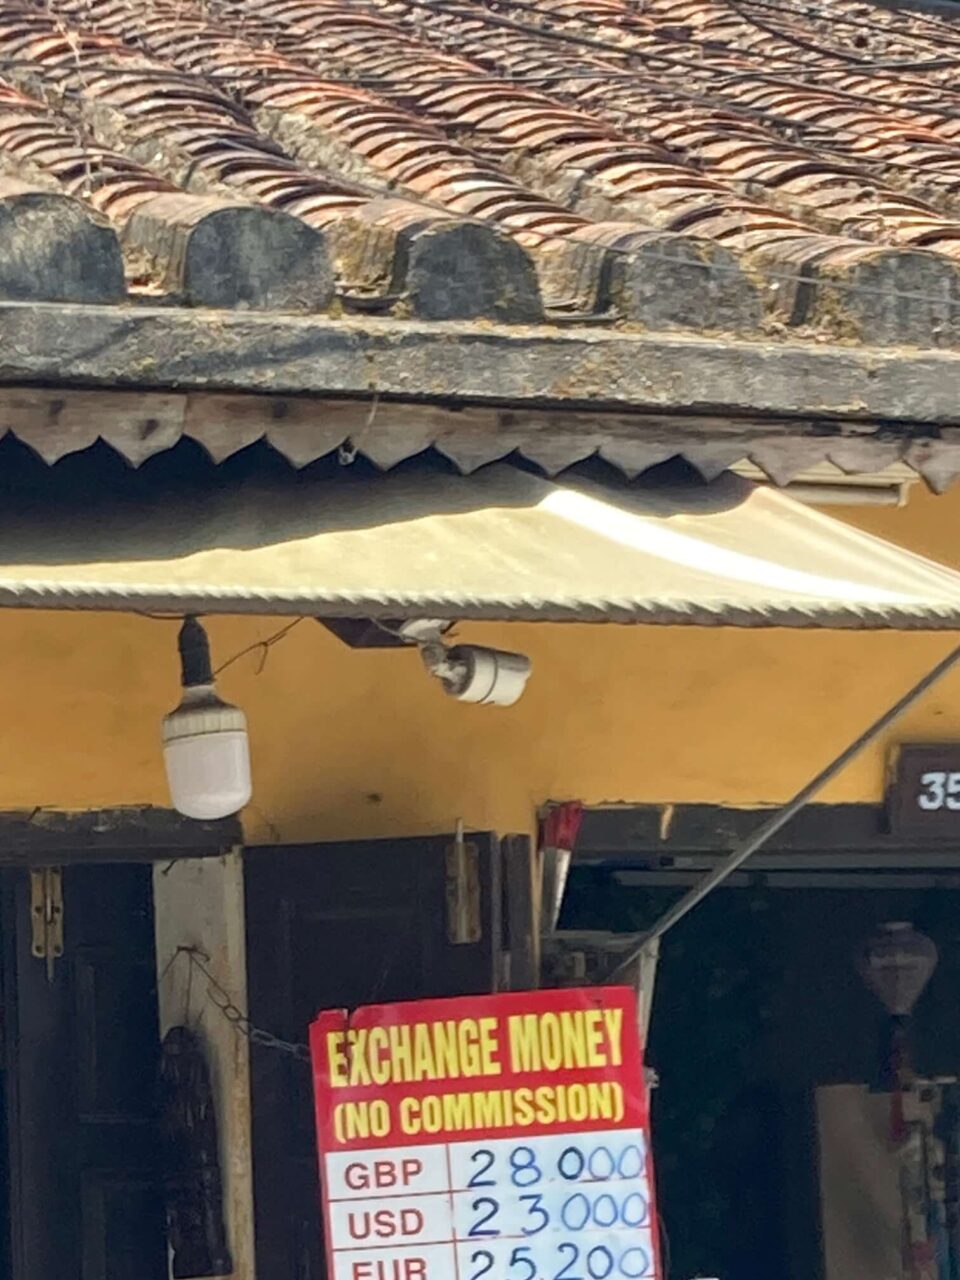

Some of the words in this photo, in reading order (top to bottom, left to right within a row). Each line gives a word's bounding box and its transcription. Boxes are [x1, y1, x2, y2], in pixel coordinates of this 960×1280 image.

[326, 1017, 501, 1087] EXCHANGE
[509, 1009, 623, 1072] MONEY
[334, 1101, 390, 1143] (NO
[400, 1082, 625, 1134] COMMISSION)
[344, 1160, 424, 1190] GBP
[349, 1209, 424, 1239] USD
